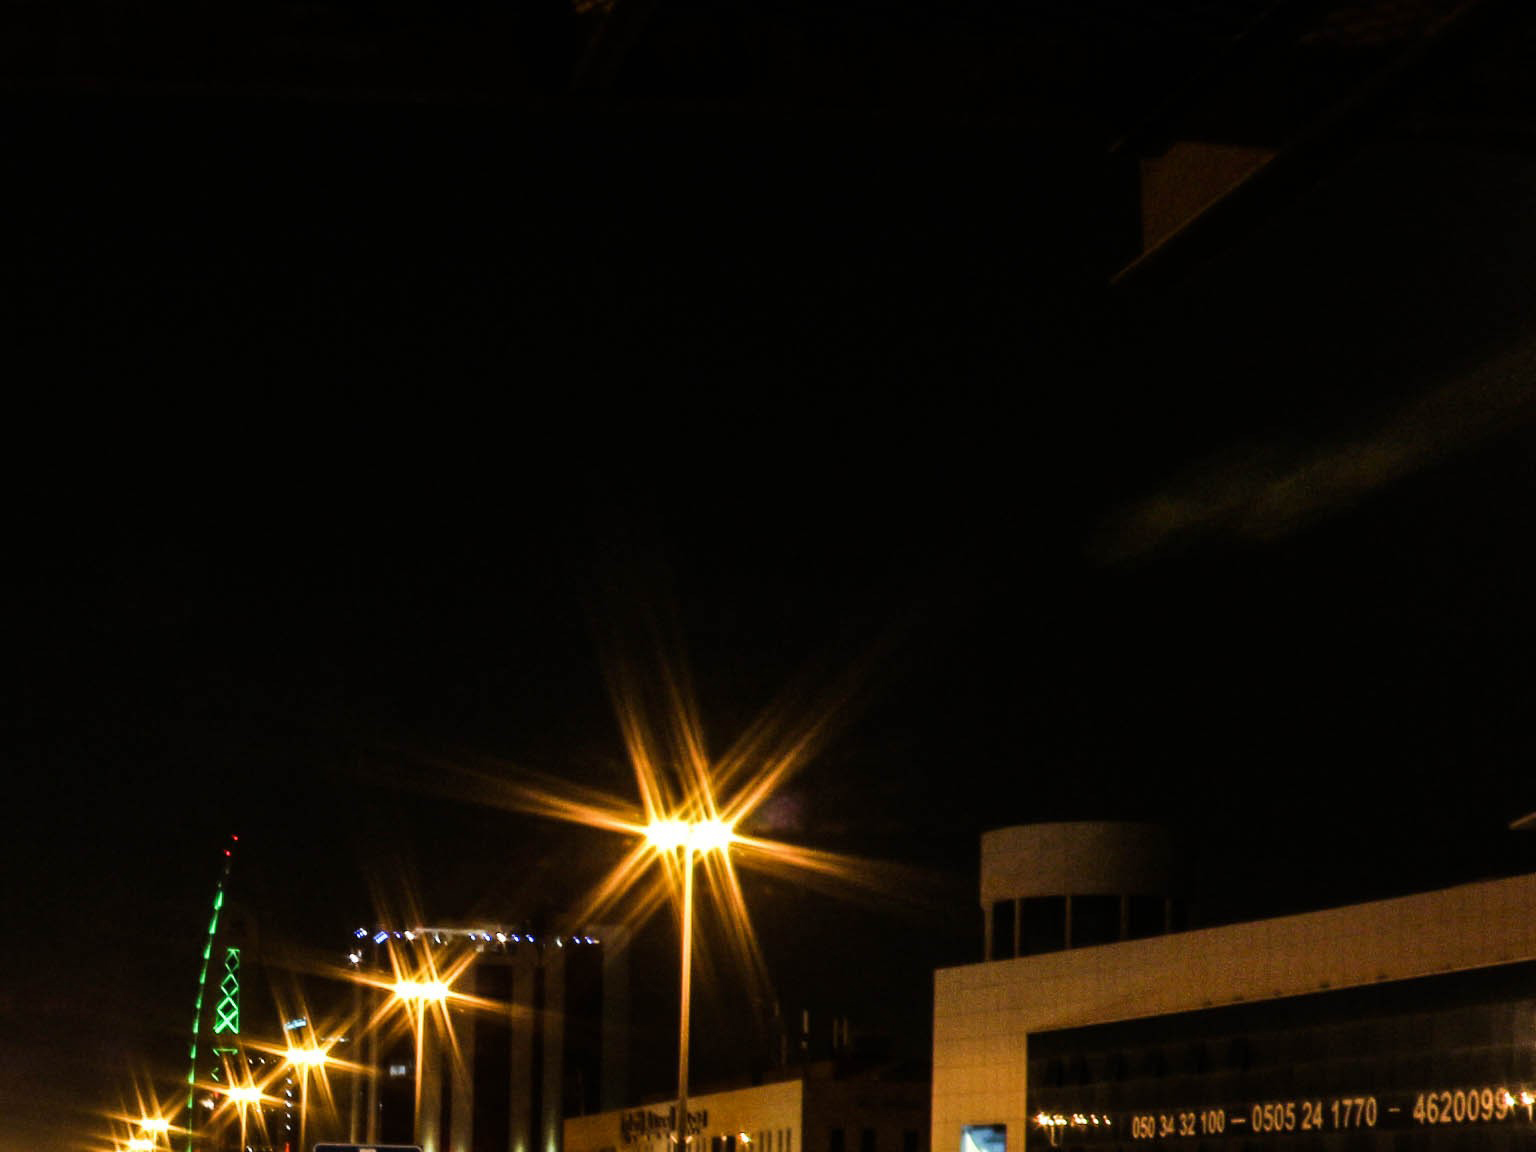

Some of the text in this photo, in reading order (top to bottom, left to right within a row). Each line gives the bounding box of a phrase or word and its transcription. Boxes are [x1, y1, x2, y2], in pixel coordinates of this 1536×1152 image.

[1132, 1115, 1156, 1139] 050
[1159, 1114, 1175, 1137] 34
[1179, 1112, 1196, 1136] 32
[1201, 1109, 1225, 1134] 100
[1251, 1103, 1296, 1132] 0505
[1301, 1101, 1323, 1130] 24
[1331, 1097, 1377, 1128] 1770
[1412, 1087, 1508, 1124] 4620099
